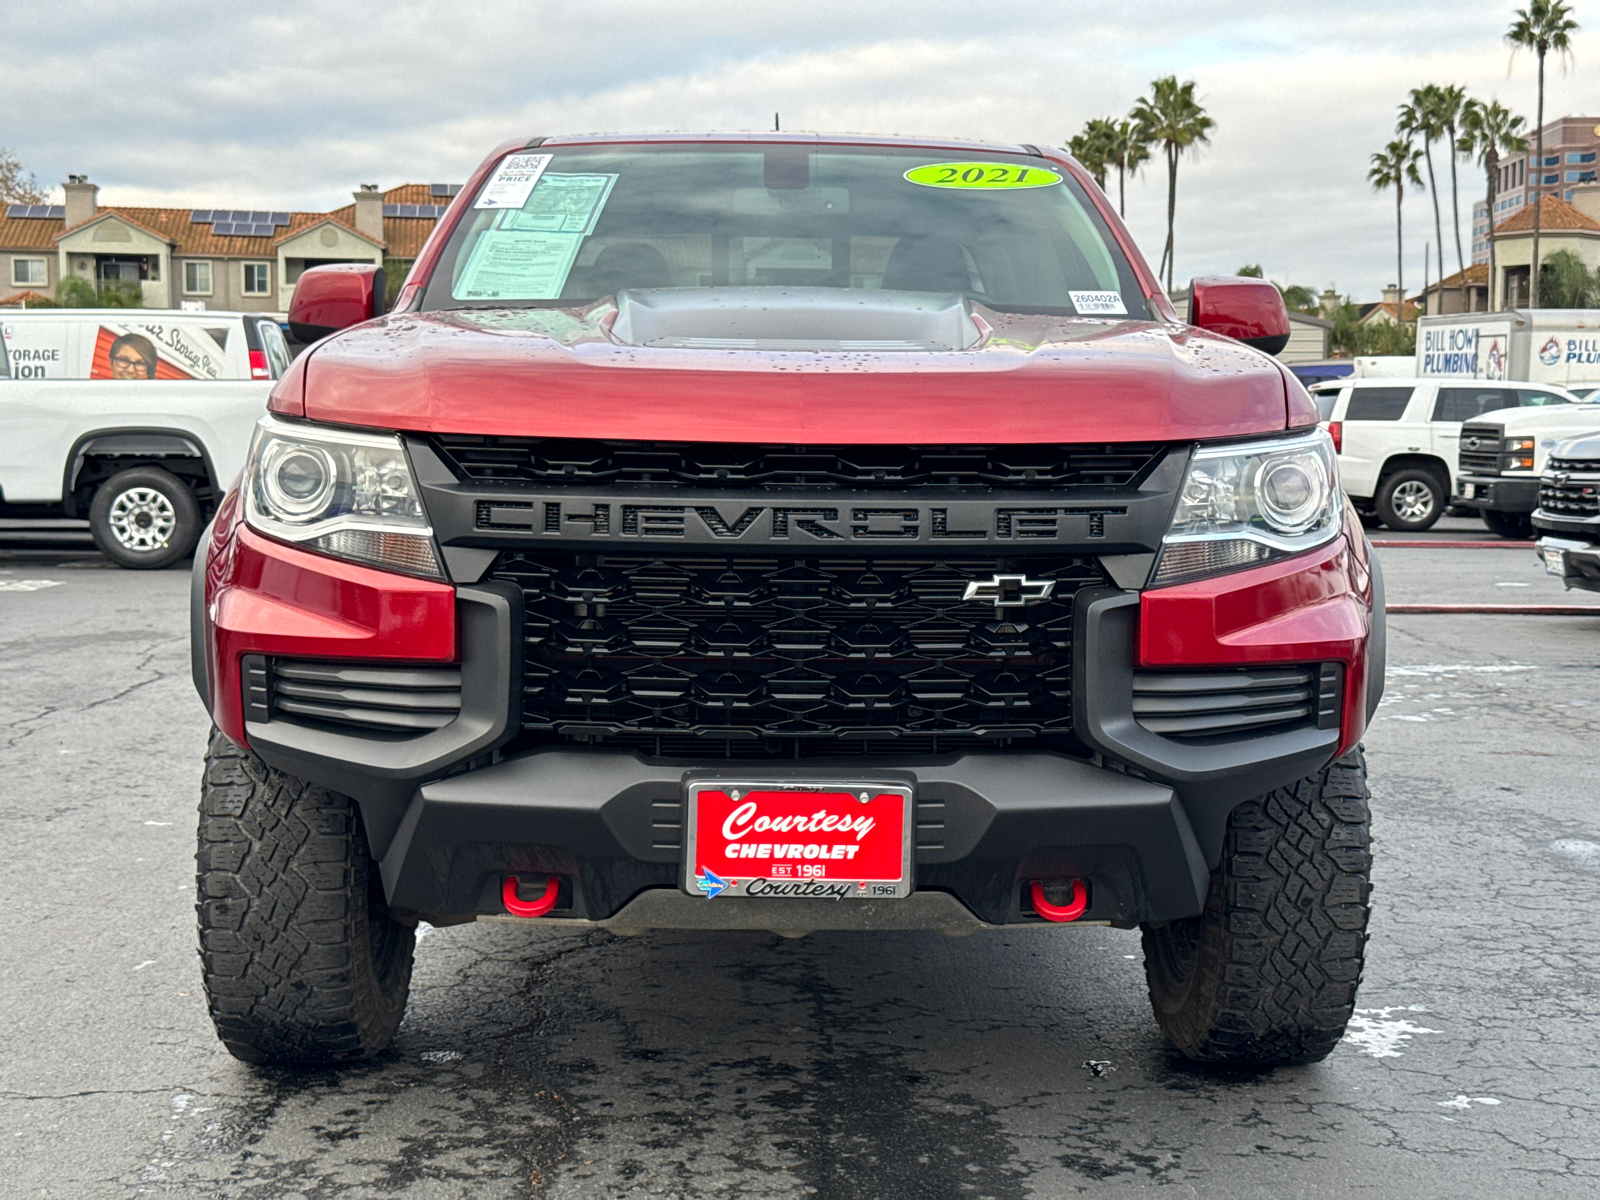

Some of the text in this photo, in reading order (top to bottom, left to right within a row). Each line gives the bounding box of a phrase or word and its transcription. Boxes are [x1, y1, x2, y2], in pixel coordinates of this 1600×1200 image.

[935, 168, 1029, 183] 2021
[1074, 295, 1120, 303] 260402A
[165, 328, 202, 368] Storage
[1425, 330, 1445, 352] BILL
[1566, 339, 1598, 352] BILL
[475, 500, 1129, 540] CHEVROLET
[722, 802, 876, 841] Courtesy
[725, 843, 859, 859] CHEVROLET
[772, 864, 826, 877] EST 1961
[745, 877, 897, 900] Courtesy 1961
